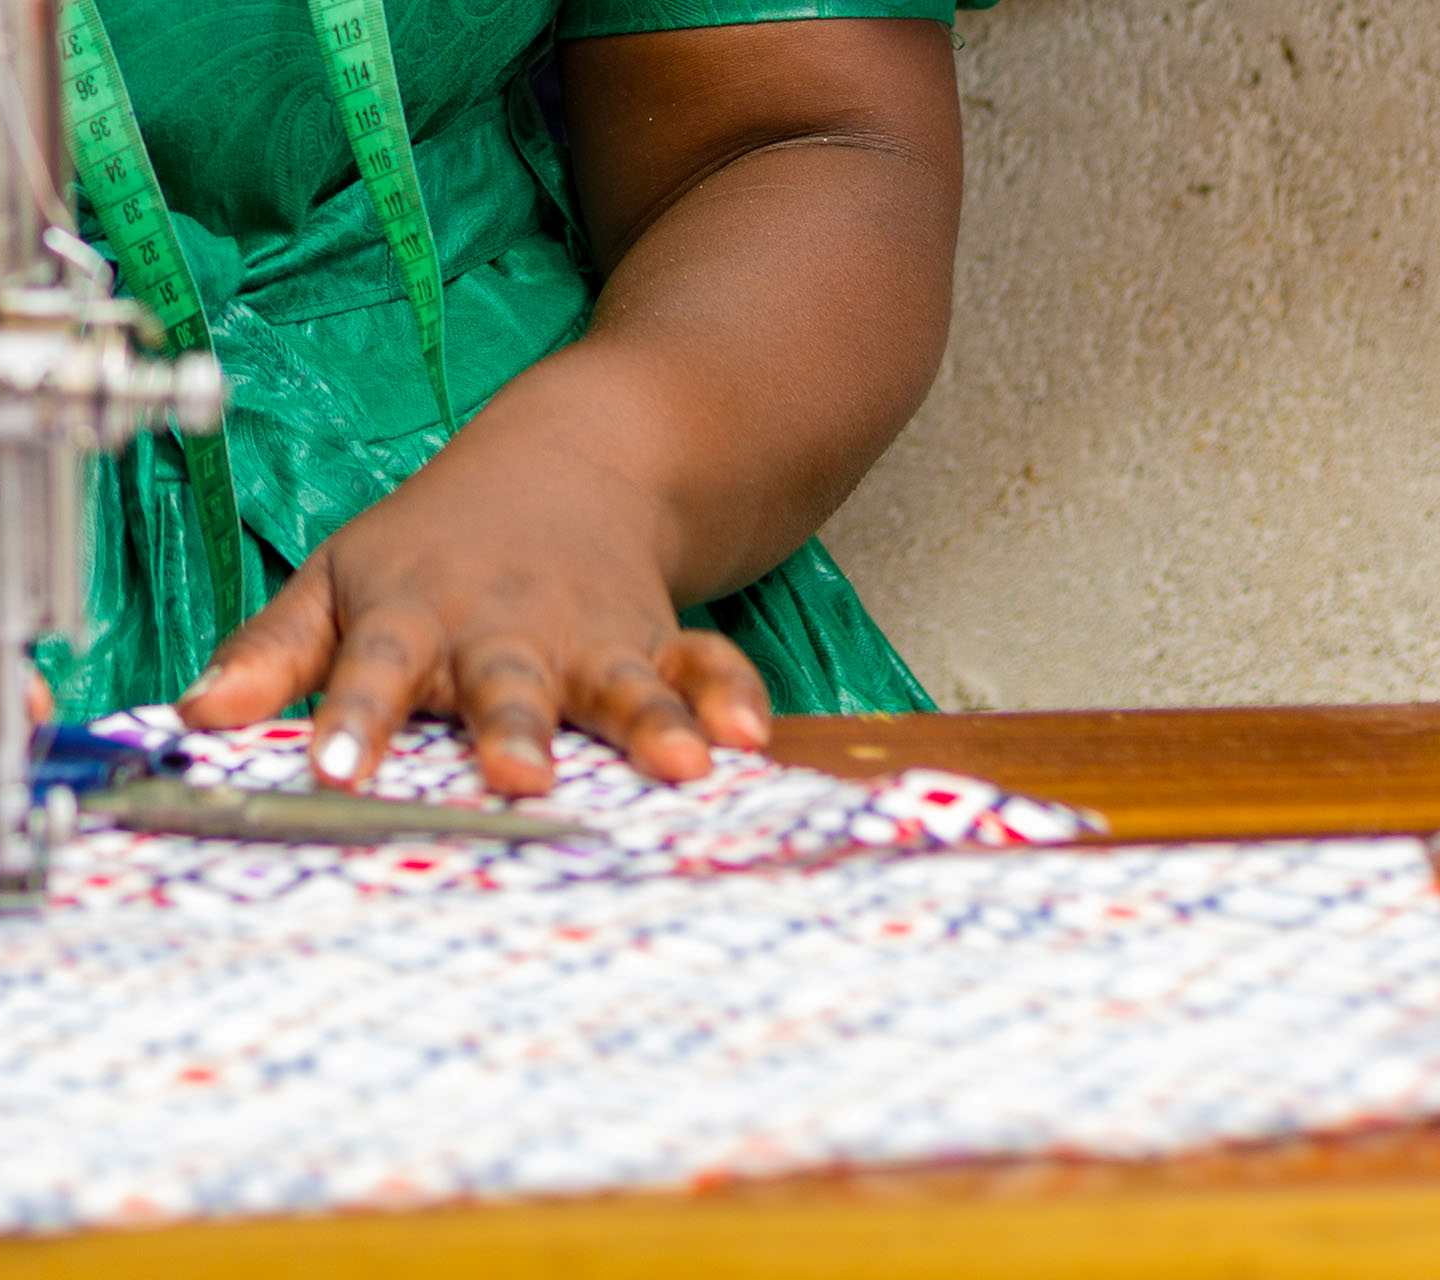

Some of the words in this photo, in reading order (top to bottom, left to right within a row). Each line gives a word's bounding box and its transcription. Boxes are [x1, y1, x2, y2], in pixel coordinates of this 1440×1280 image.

[332, 17, 363, 46] 113
[75, 74, 99, 101] 36
[343, 61, 370, 89] 114
[89, 116, 111, 141] 35
[355, 104, 381, 132] 115
[104, 157, 127, 184] 34
[122, 198, 143, 224] 33
[138, 240, 160, 266] 32
[159, 281, 179, 306] 31
